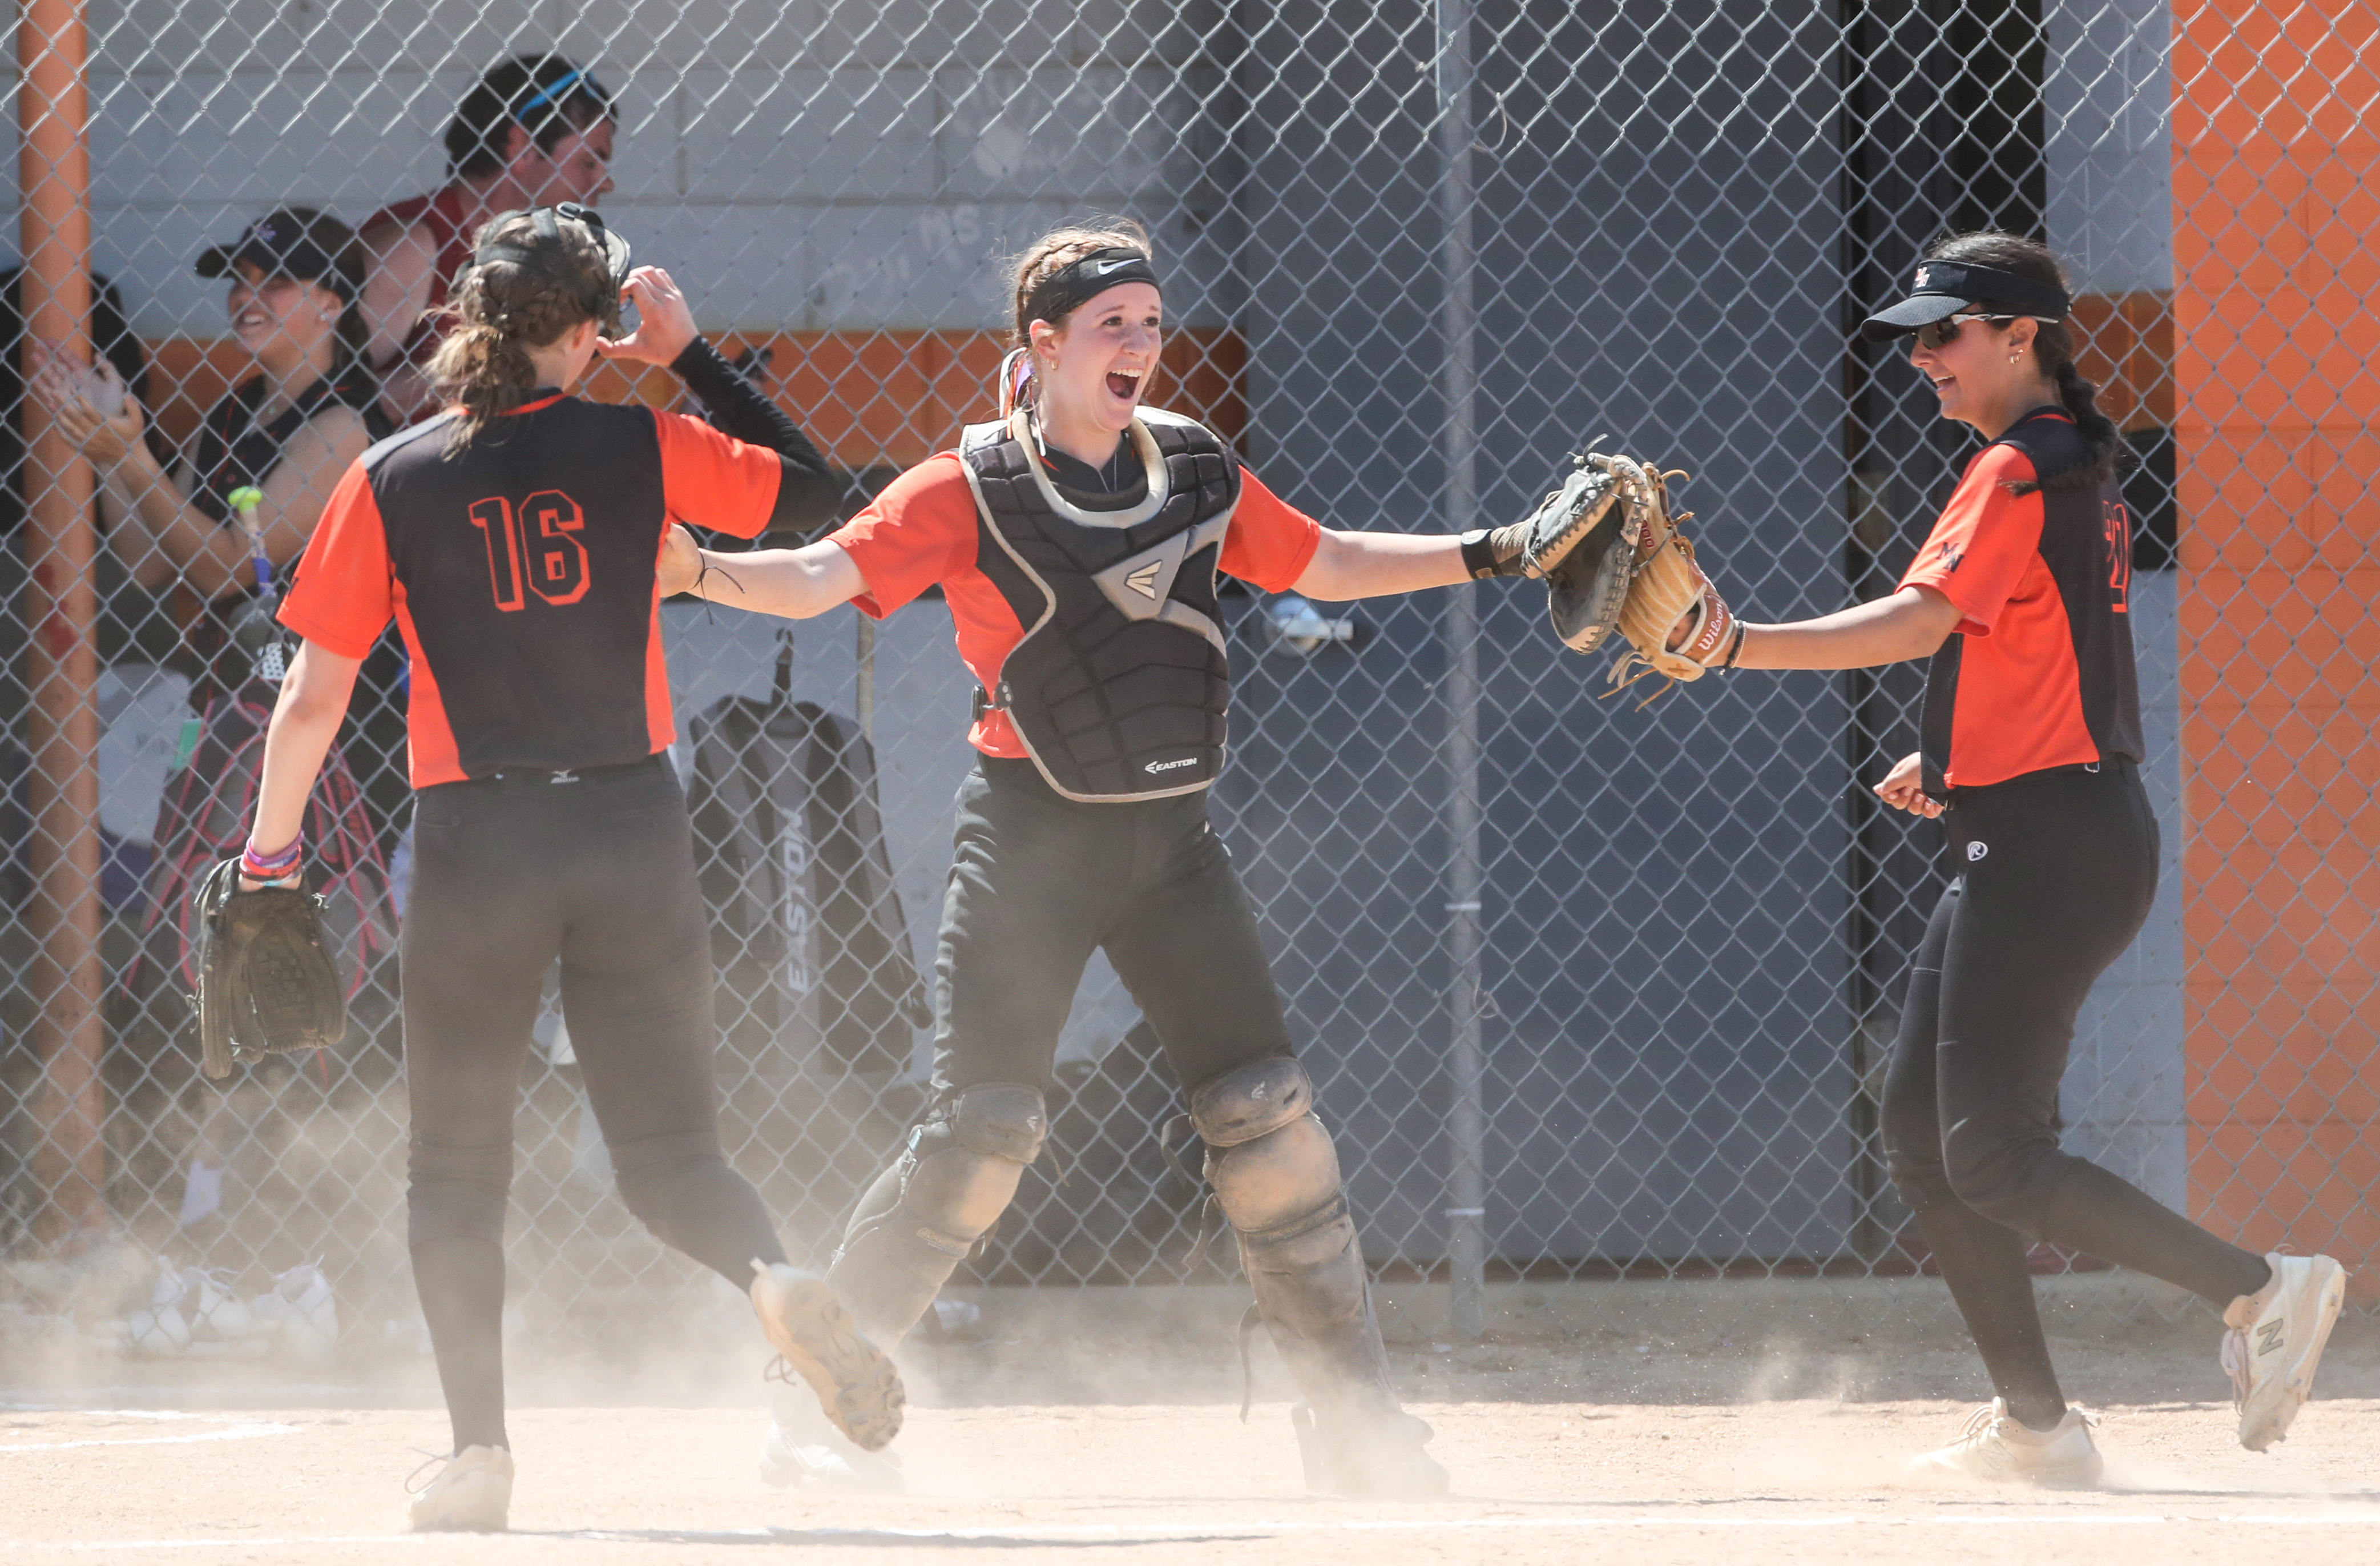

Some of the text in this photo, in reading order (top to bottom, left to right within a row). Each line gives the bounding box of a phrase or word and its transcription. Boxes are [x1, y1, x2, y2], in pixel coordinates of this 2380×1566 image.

[468, 489, 591, 612] 16
[1697, 602, 1724, 650] Wilson
[1155, 757, 1198, 771] EASTON
